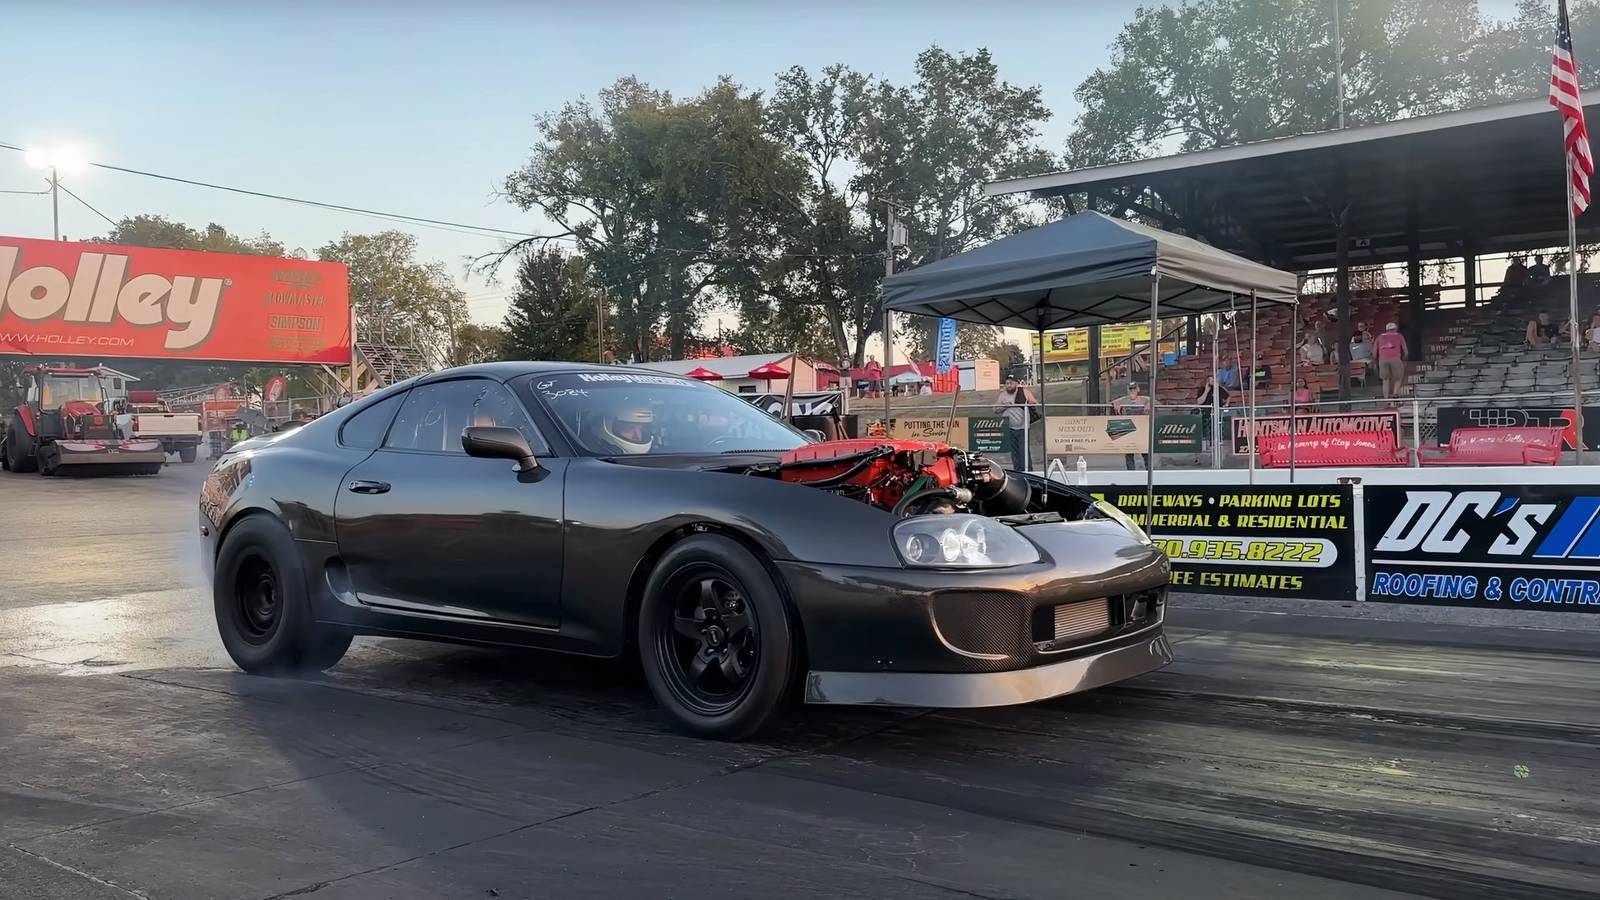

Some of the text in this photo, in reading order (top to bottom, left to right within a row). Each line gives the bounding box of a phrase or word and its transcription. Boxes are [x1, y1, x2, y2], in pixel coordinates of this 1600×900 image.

[0, 246, 224, 350] olley
[577, 373, 632, 383] Holley
[903, 420, 931, 429] PUTTING
[933, 420, 945, 429] THE
[973, 419, 1005, 429] Mint
[1158, 423, 1197, 434] Mint
[1237, 415, 1394, 437] HNTSMN AUTOMOTIVE
[1320, 438, 1330, 449] of
[1352, 439, 1376, 449] Jones
[1219, 494, 1292, 508] PARKING
[1297, 494, 1342, 508] LOTS
[1128, 513, 1348, 529] MMERCIAL & RESIDENTIAL
[1200, 572, 1303, 590] ESTIMATES
[1372, 572, 1600, 605] ROOFING & CONTR
